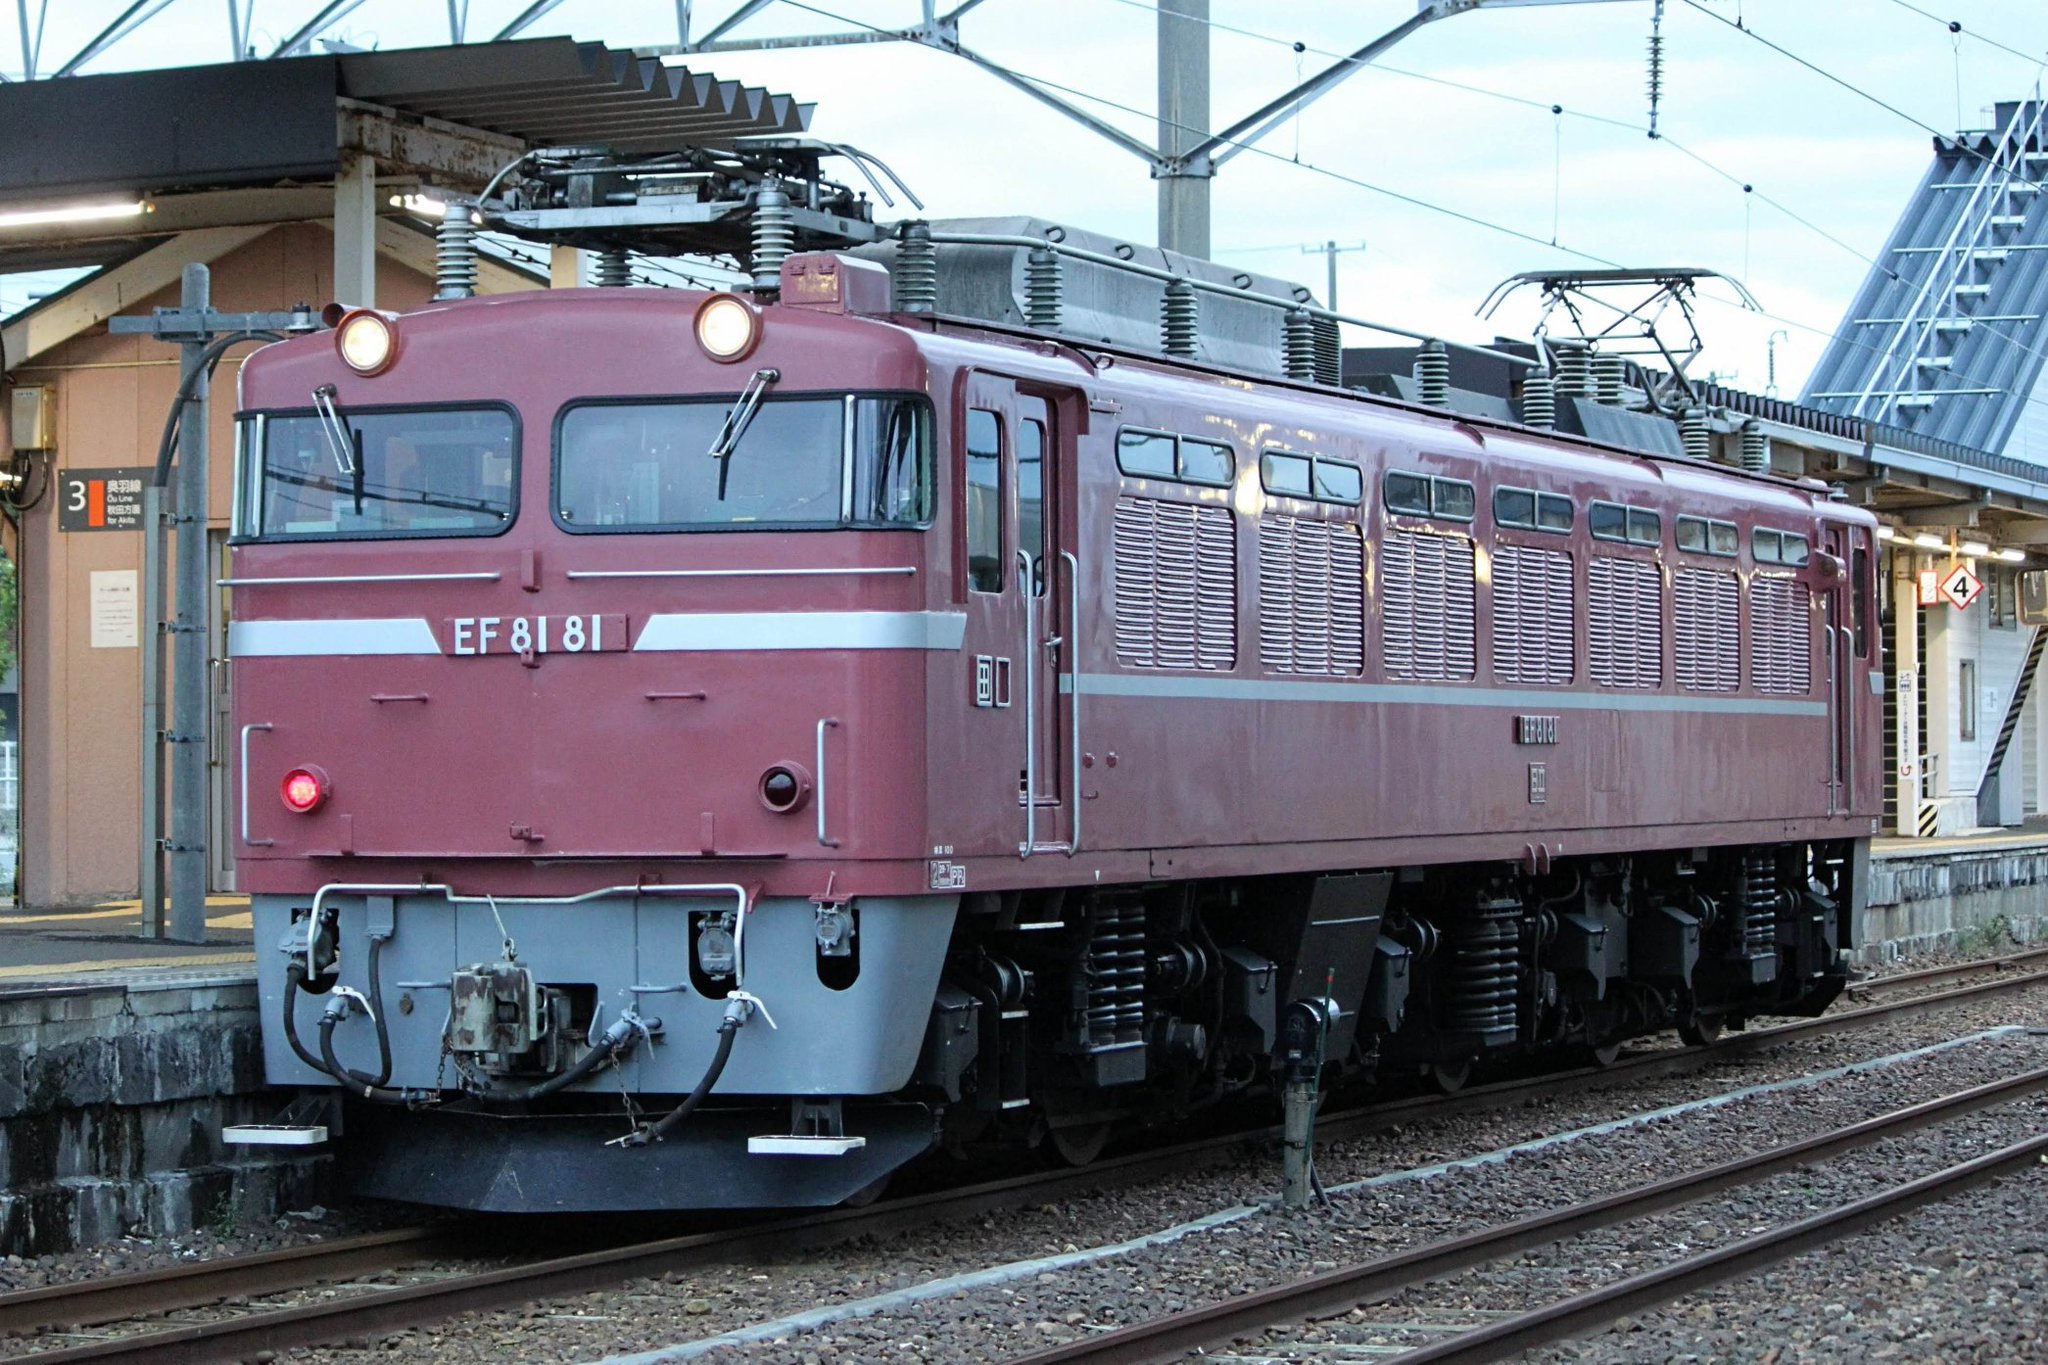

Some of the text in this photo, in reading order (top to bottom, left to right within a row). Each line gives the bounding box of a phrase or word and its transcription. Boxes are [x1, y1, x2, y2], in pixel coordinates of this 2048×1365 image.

[107, 479, 141, 493] 奥羽線
[68, 480, 86, 511] 3
[118, 495, 133, 503] Line
[118, 516, 136, 524] Akita
[1953, 575, 1969, 598] 4
[562, 614, 601, 652] 81
